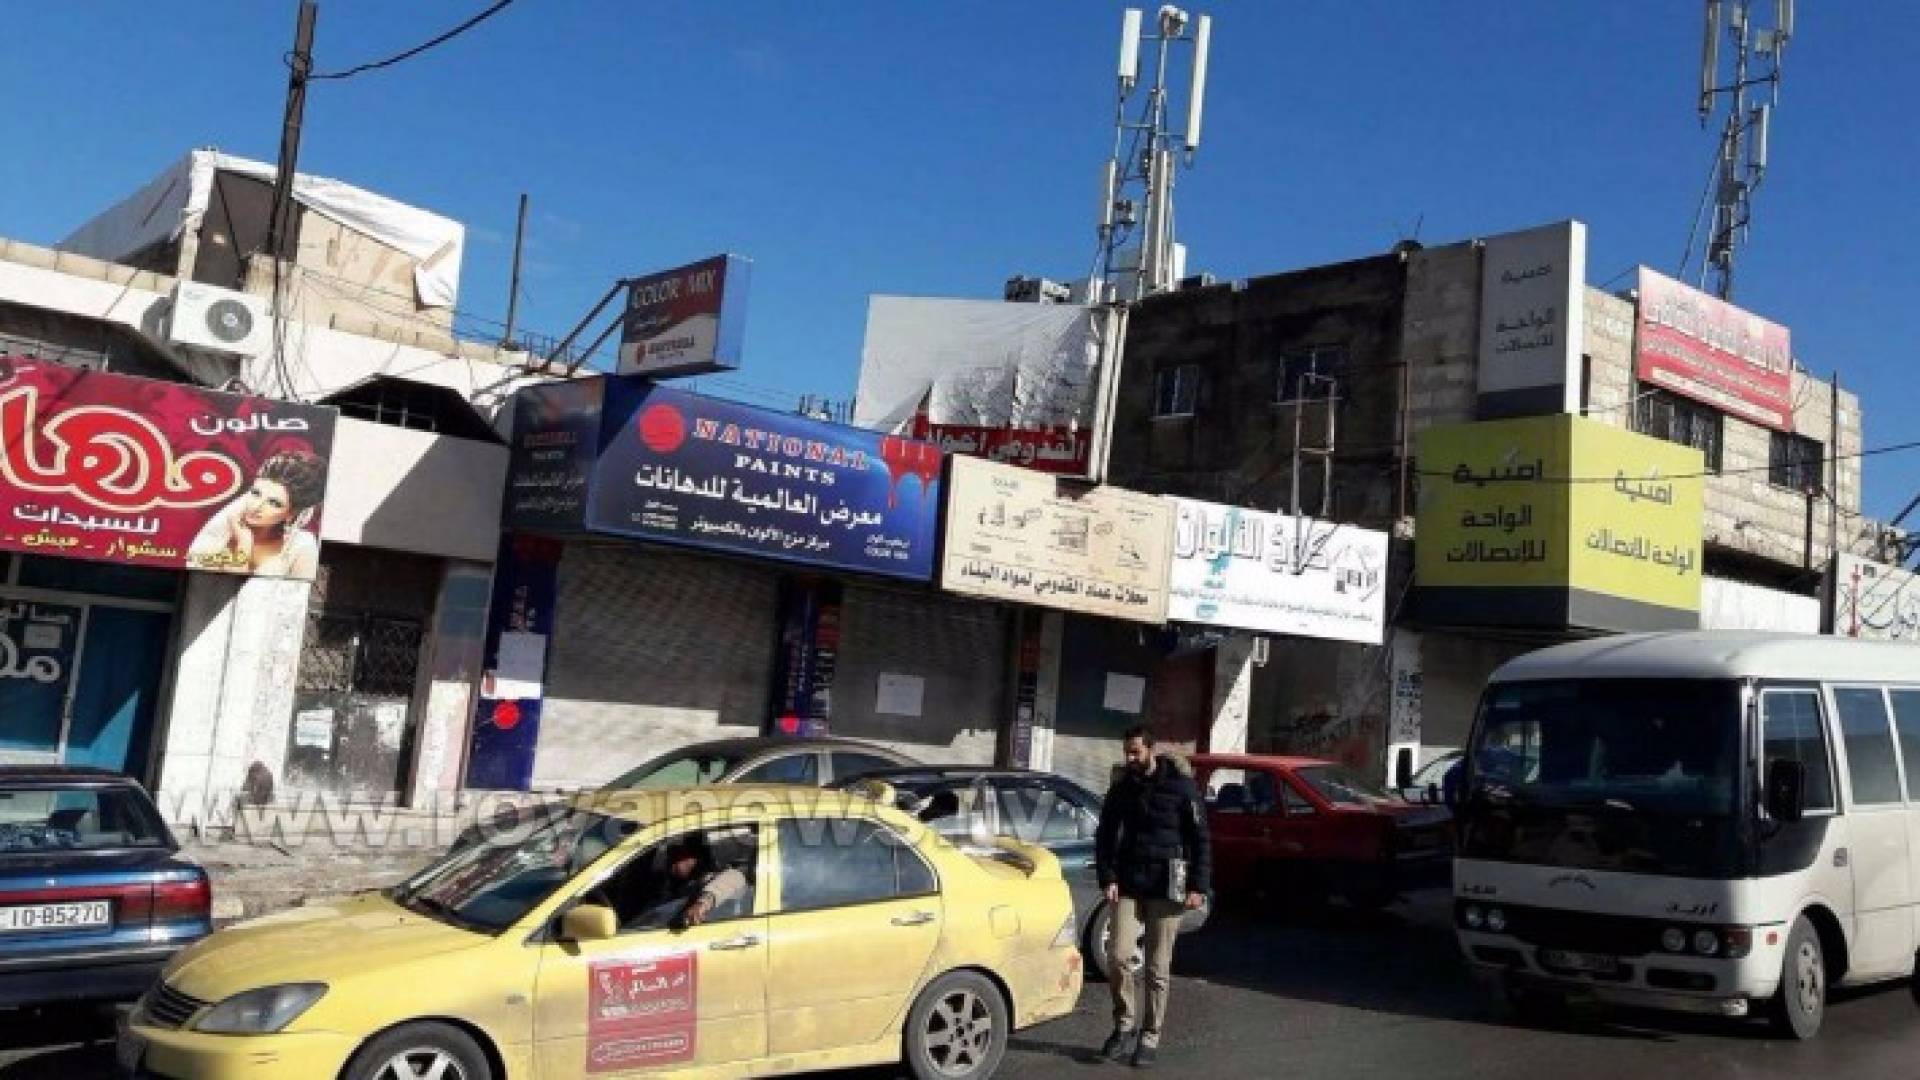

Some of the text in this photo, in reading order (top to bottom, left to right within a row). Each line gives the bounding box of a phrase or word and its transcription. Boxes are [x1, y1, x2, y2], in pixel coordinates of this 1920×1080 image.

[189, 413, 309, 435] صالون
[692, 418, 871, 471] NATIONAL
[734, 453, 836, 485] PAINTS
[635, 464, 883, 529] معرض العالمية للدهانات
[13, 504, 161, 534] للسيدات
